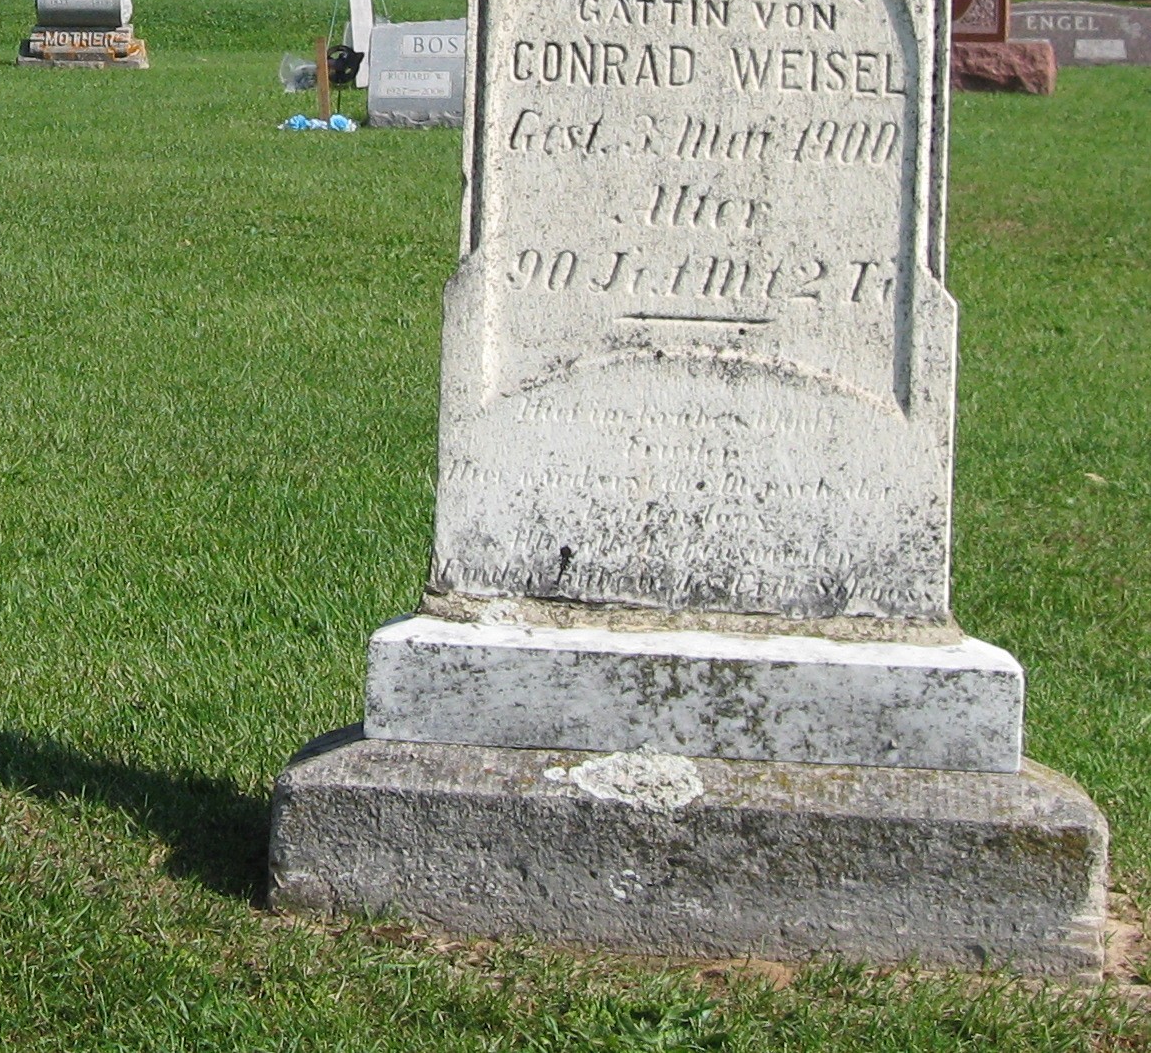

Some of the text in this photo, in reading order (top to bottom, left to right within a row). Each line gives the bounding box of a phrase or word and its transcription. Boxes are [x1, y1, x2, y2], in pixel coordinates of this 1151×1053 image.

[755, 1, 838, 33] VON
[1026, 15, 1100, 31] ENGEL
[45, 31, 115, 47] MOTHER
[512, 40, 907, 98] CONRAD WEISEL
[790, 119, 899, 165] 1900
[505, 248, 579, 293] 90
[795, 258, 829, 302] 2
